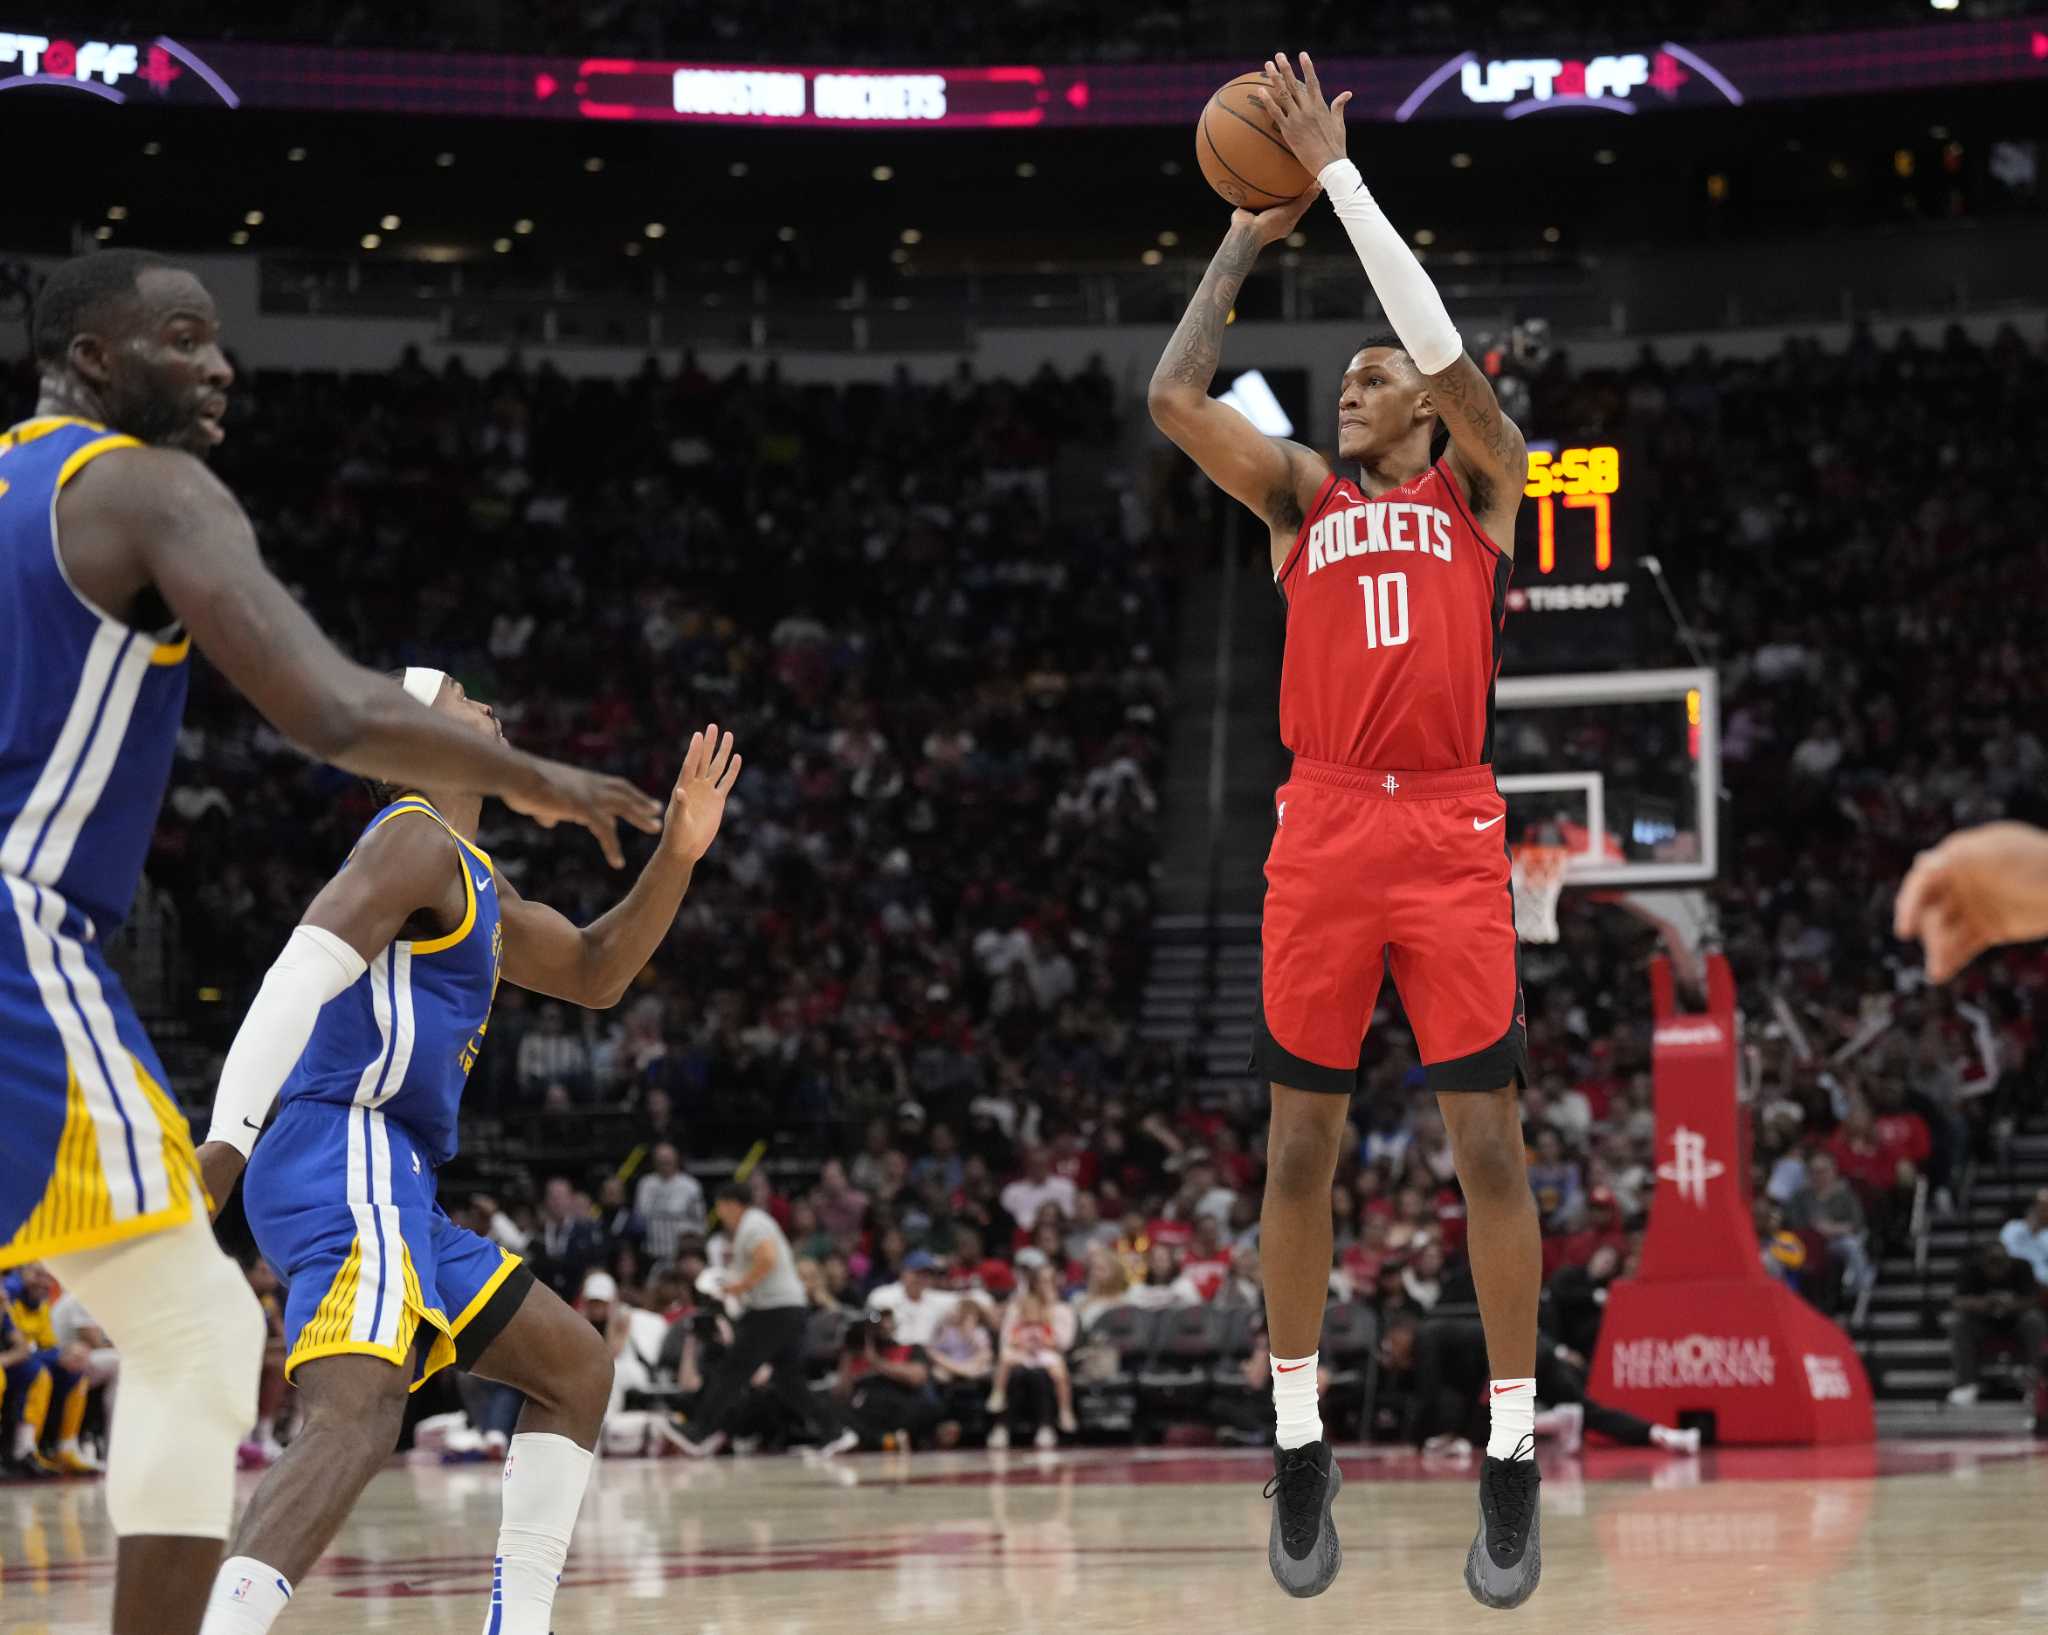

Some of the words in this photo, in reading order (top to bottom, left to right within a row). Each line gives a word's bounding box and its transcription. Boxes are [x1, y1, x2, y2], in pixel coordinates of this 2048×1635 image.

[1523, 446, 1620, 498] 5:58
[1308, 502, 1453, 576] ROCKETS
[1538, 494, 1612, 574] 17
[1357, 572, 1410, 649] 10
[1527, 582, 1630, 611] TISSOT
[1613, 1335, 1772, 1366] MEMORIAL
[1613, 1359, 1775, 1388] HERMANN
